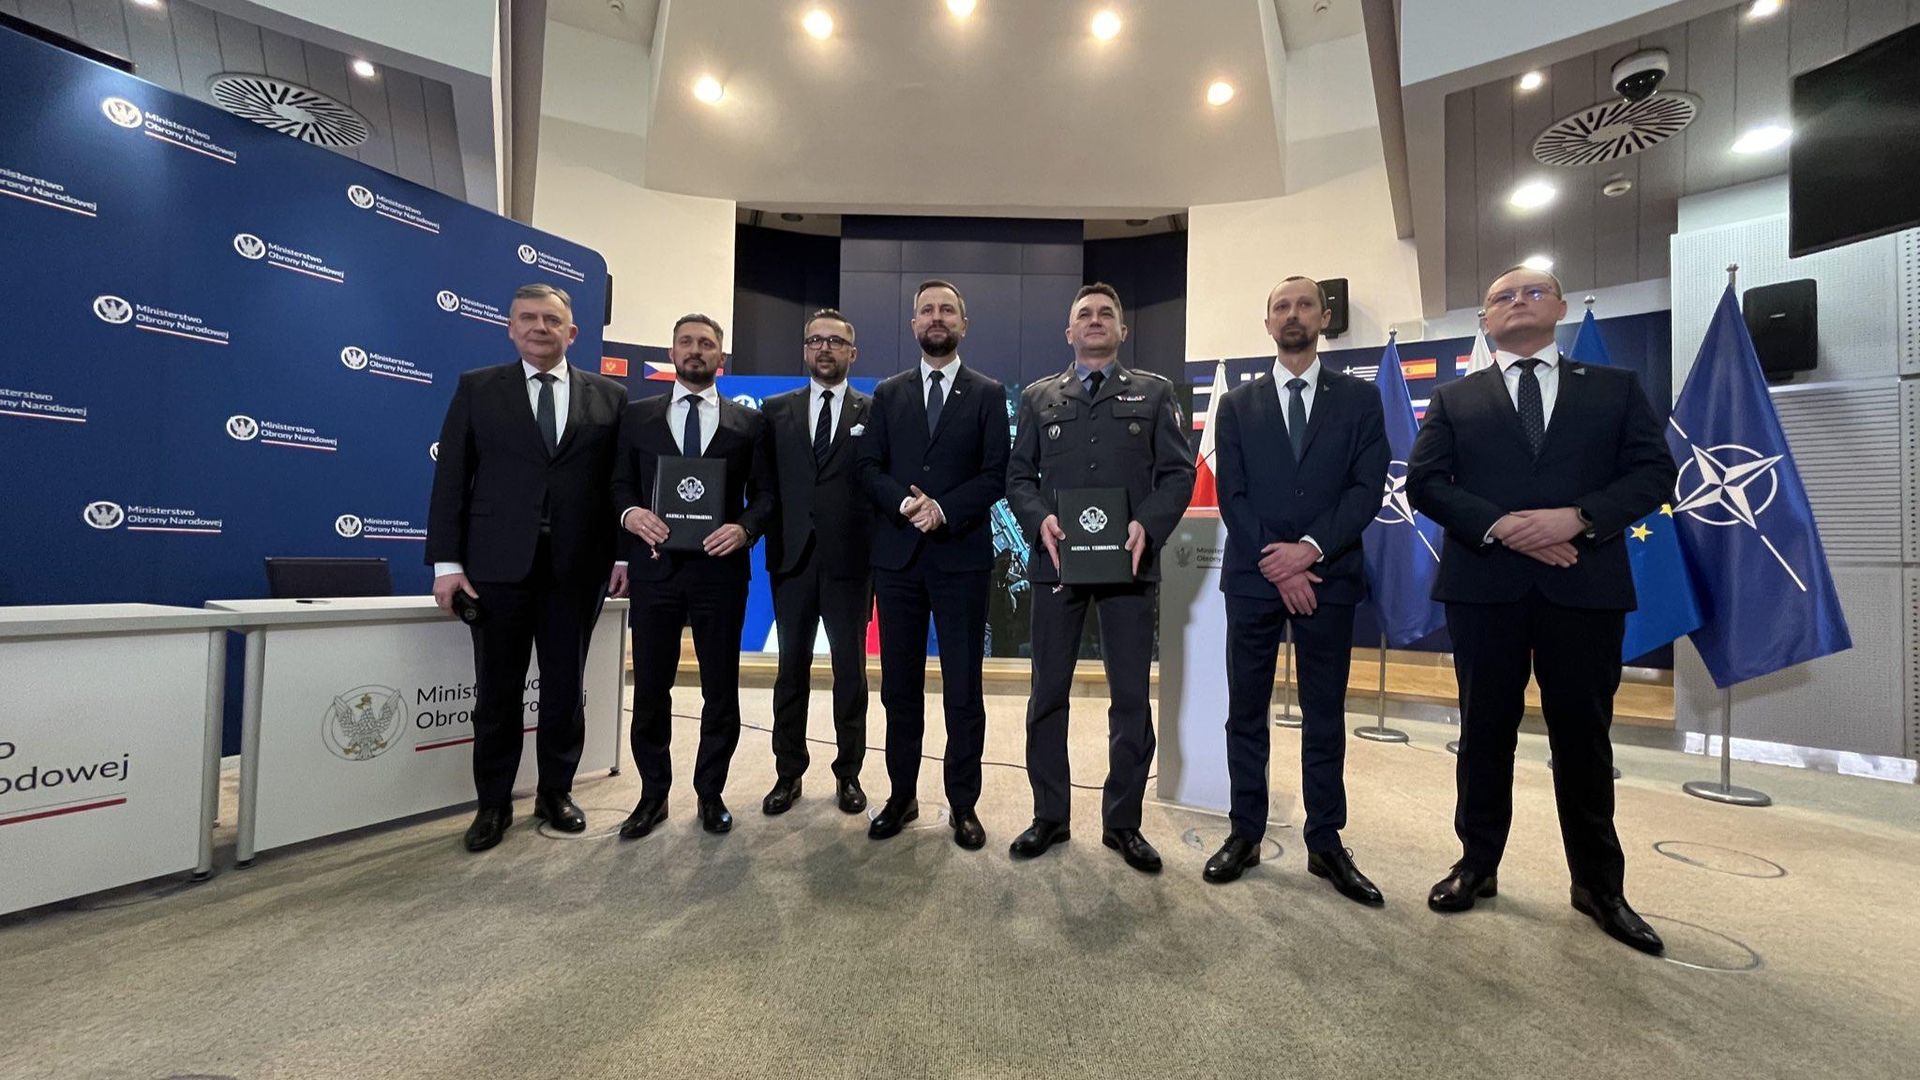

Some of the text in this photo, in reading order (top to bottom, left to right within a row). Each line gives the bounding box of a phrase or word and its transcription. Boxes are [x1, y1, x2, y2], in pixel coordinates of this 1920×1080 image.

[145, 111, 210, 140] Ministerstwo
[145, 121, 237, 159] Obrony Narodowej
[0, 168, 64, 191] nisterstwo
[32, 186, 97, 211] Narodowej
[376, 194, 421, 215] Ministerstwo
[376, 202, 440, 230] Obrony Narodowej
[268, 243, 322, 263] Ministerstwo
[538, 251, 571, 267] Ministerstwo
[268, 251, 344, 279] Obrony Narodowej
[538, 258, 584, 279] Obrony Narodowej
[136, 304, 202, 324] Ministerstwo
[460, 297, 499, 312] Ministerstwo
[460, 304, 483, 315] Obrony
[136, 313, 229, 339] Obrony Narodowej
[369, 352, 414, 367] Ministerstwo
[369, 360, 433, 379] Obrony Narodowej
[0, 388, 53, 401] sterstwo
[21, 400, 87, 416] Narodowej
[261, 420, 315, 434] Ministerstwo
[261, 429, 337, 446] Obrony Narodowej
[127, 505, 195, 516] Ministerstwo
[127, 515, 223, 527] Obrony Narodowej
[363, 518, 409, 526] Ministerstwo
[391, 526, 428, 536] Narodowej
[416, 710, 475, 729] Obro
[0, 753, 129, 795] odowej
